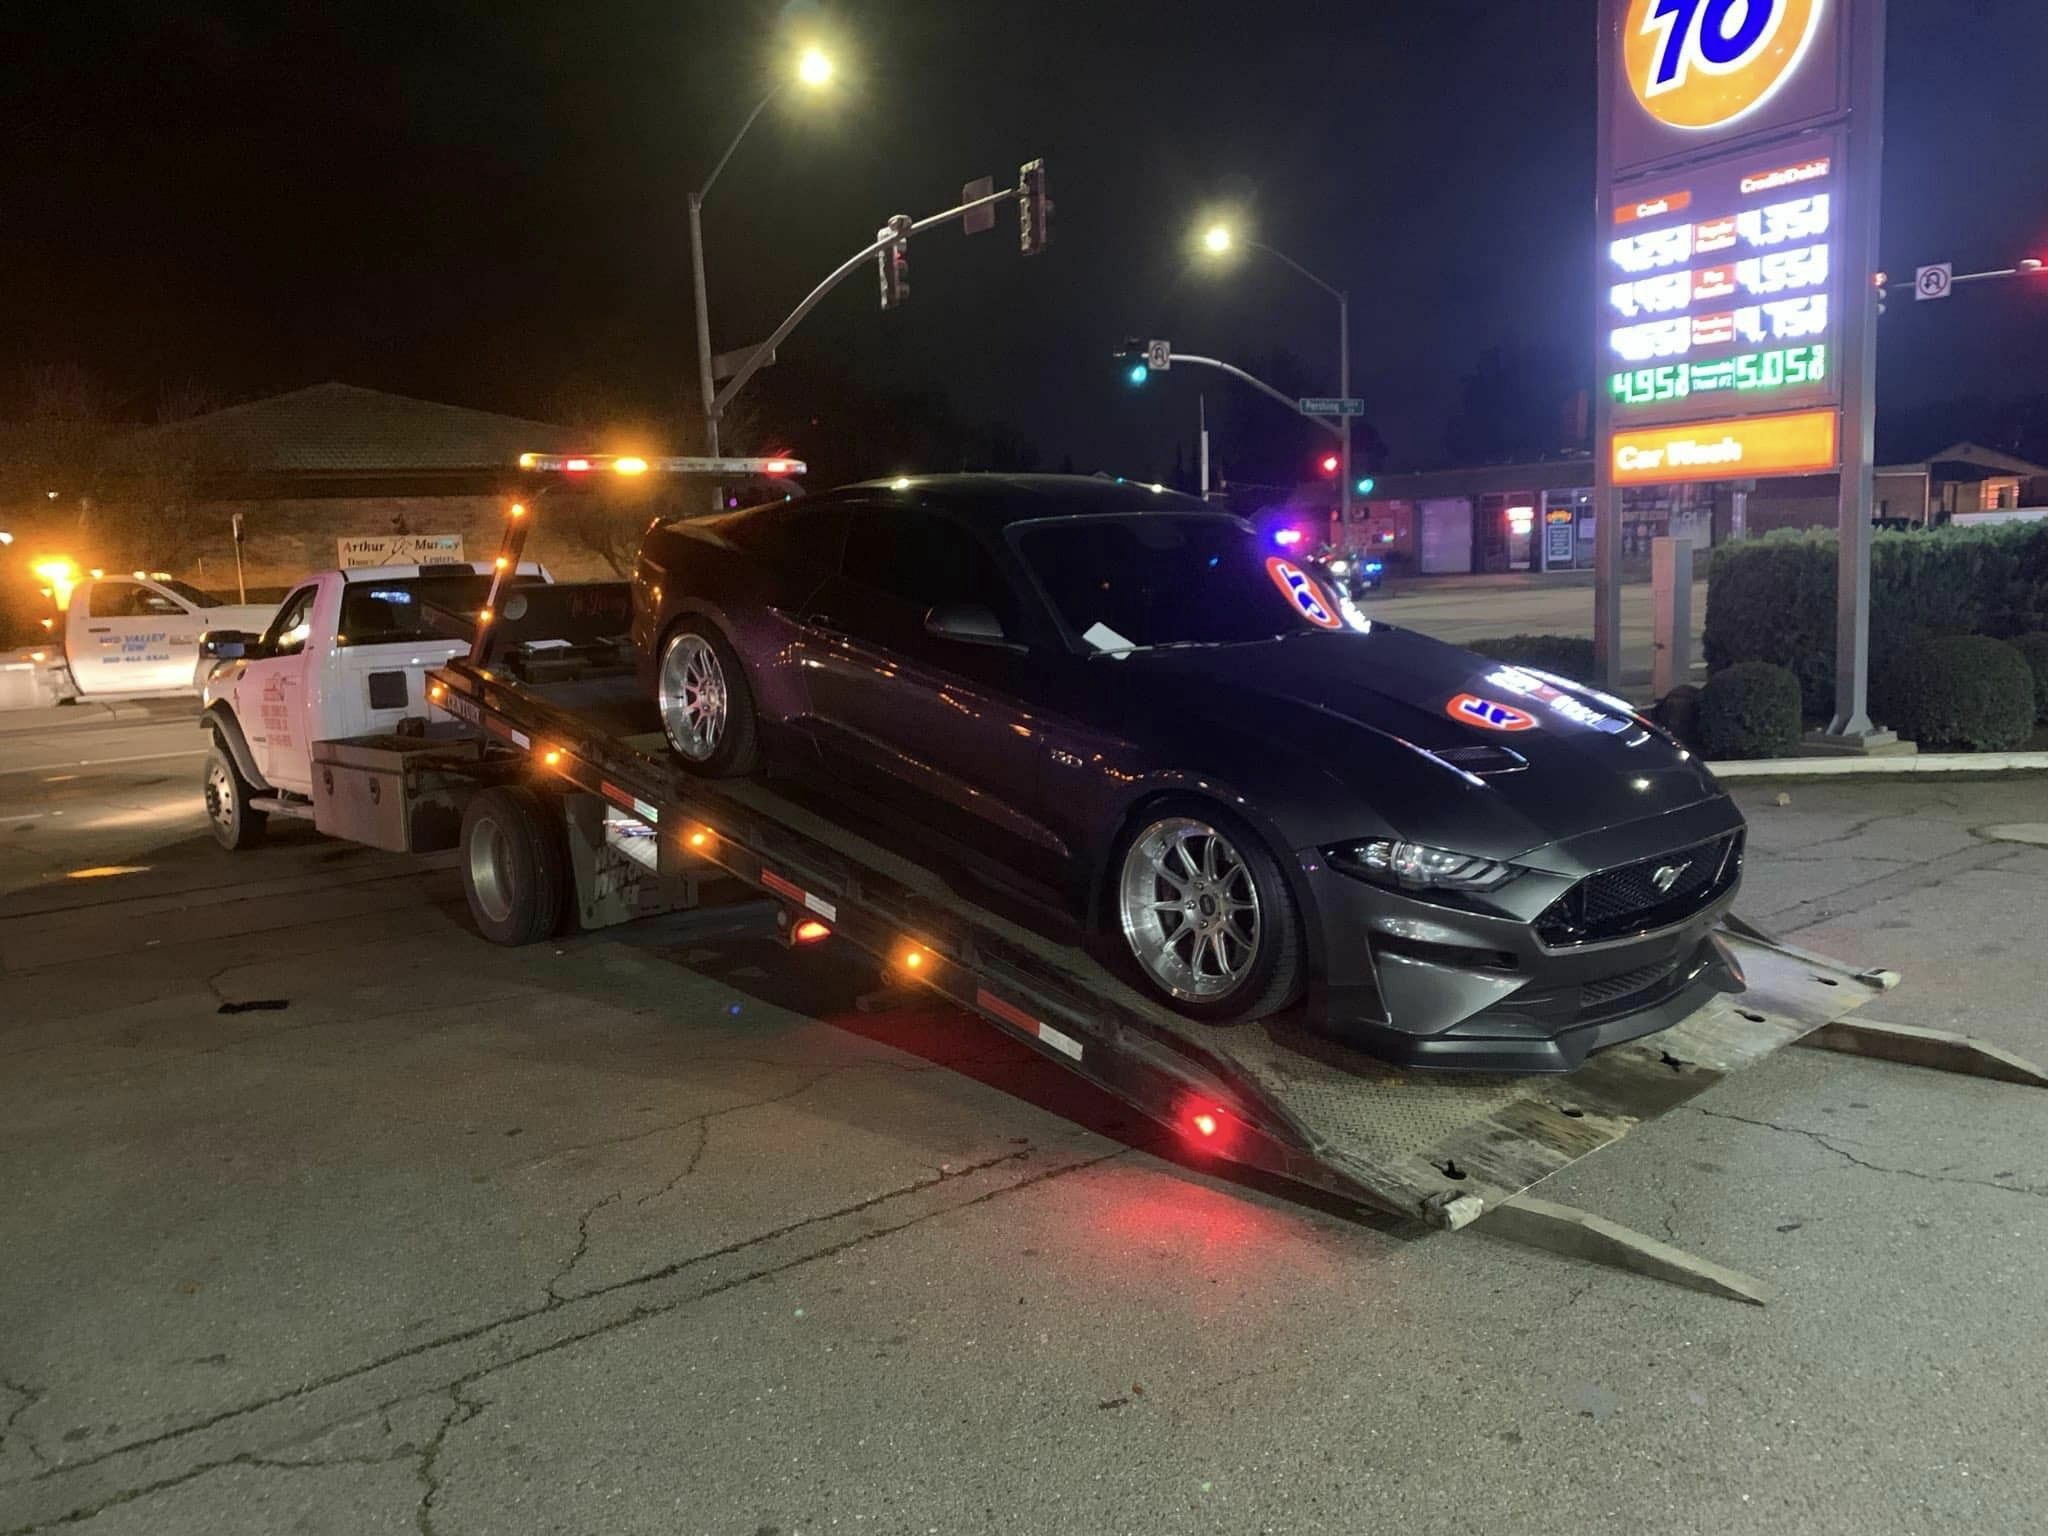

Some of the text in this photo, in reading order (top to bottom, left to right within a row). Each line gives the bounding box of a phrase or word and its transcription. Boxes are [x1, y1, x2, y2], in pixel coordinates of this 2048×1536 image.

[1616, 437, 1742, 470] Car Wash
[343, 538, 459, 552] Arthur Murray
[447, 694, 480, 725] CENTURY
